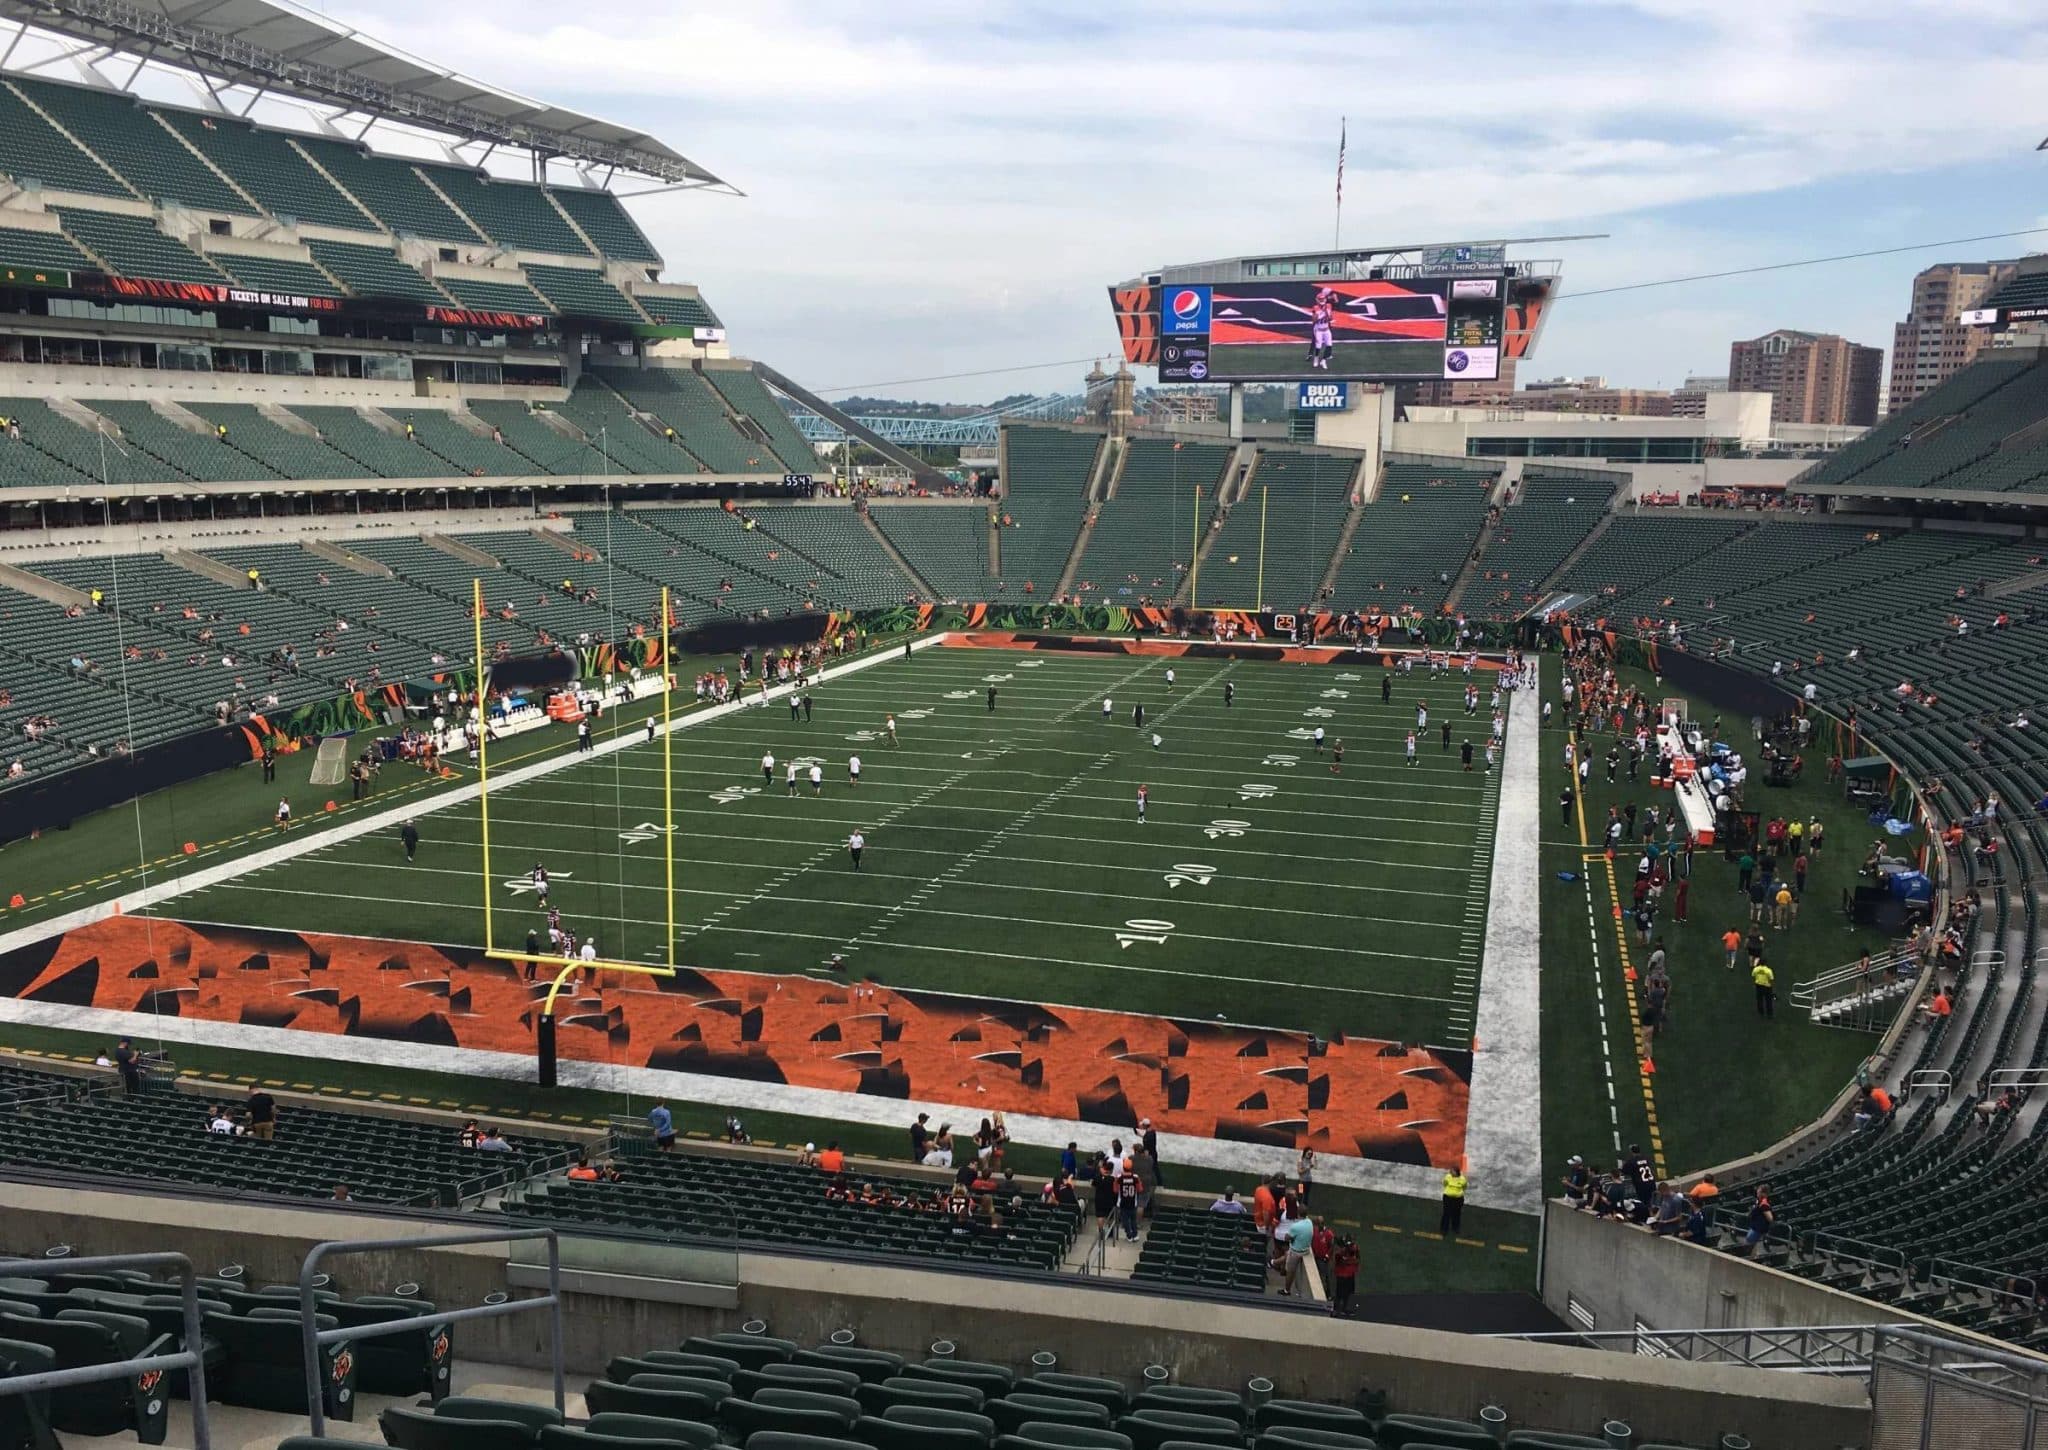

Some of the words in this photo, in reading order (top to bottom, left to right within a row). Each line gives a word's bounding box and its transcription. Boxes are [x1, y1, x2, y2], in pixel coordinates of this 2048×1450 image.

[1451, 263, 1477, 271] THIRD
[230, 290, 259, 304] TICKETS
[260, 293, 271, 304] ON
[272, 295, 290, 306] SALE
[291, 296, 309, 308] NOW
[1175, 321, 1198, 331] pepsi
[1307, 385, 1339, 396] BUD
[1301, 396, 1345, 407] LIGHT
[1279, 617, 1293, 628] 25
[1203, 820, 1251, 837] 30
[1164, 863, 1217, 886] 20
[1115, 919, 1176, 945] 10
[1122, 1185, 1136, 1198] 50
